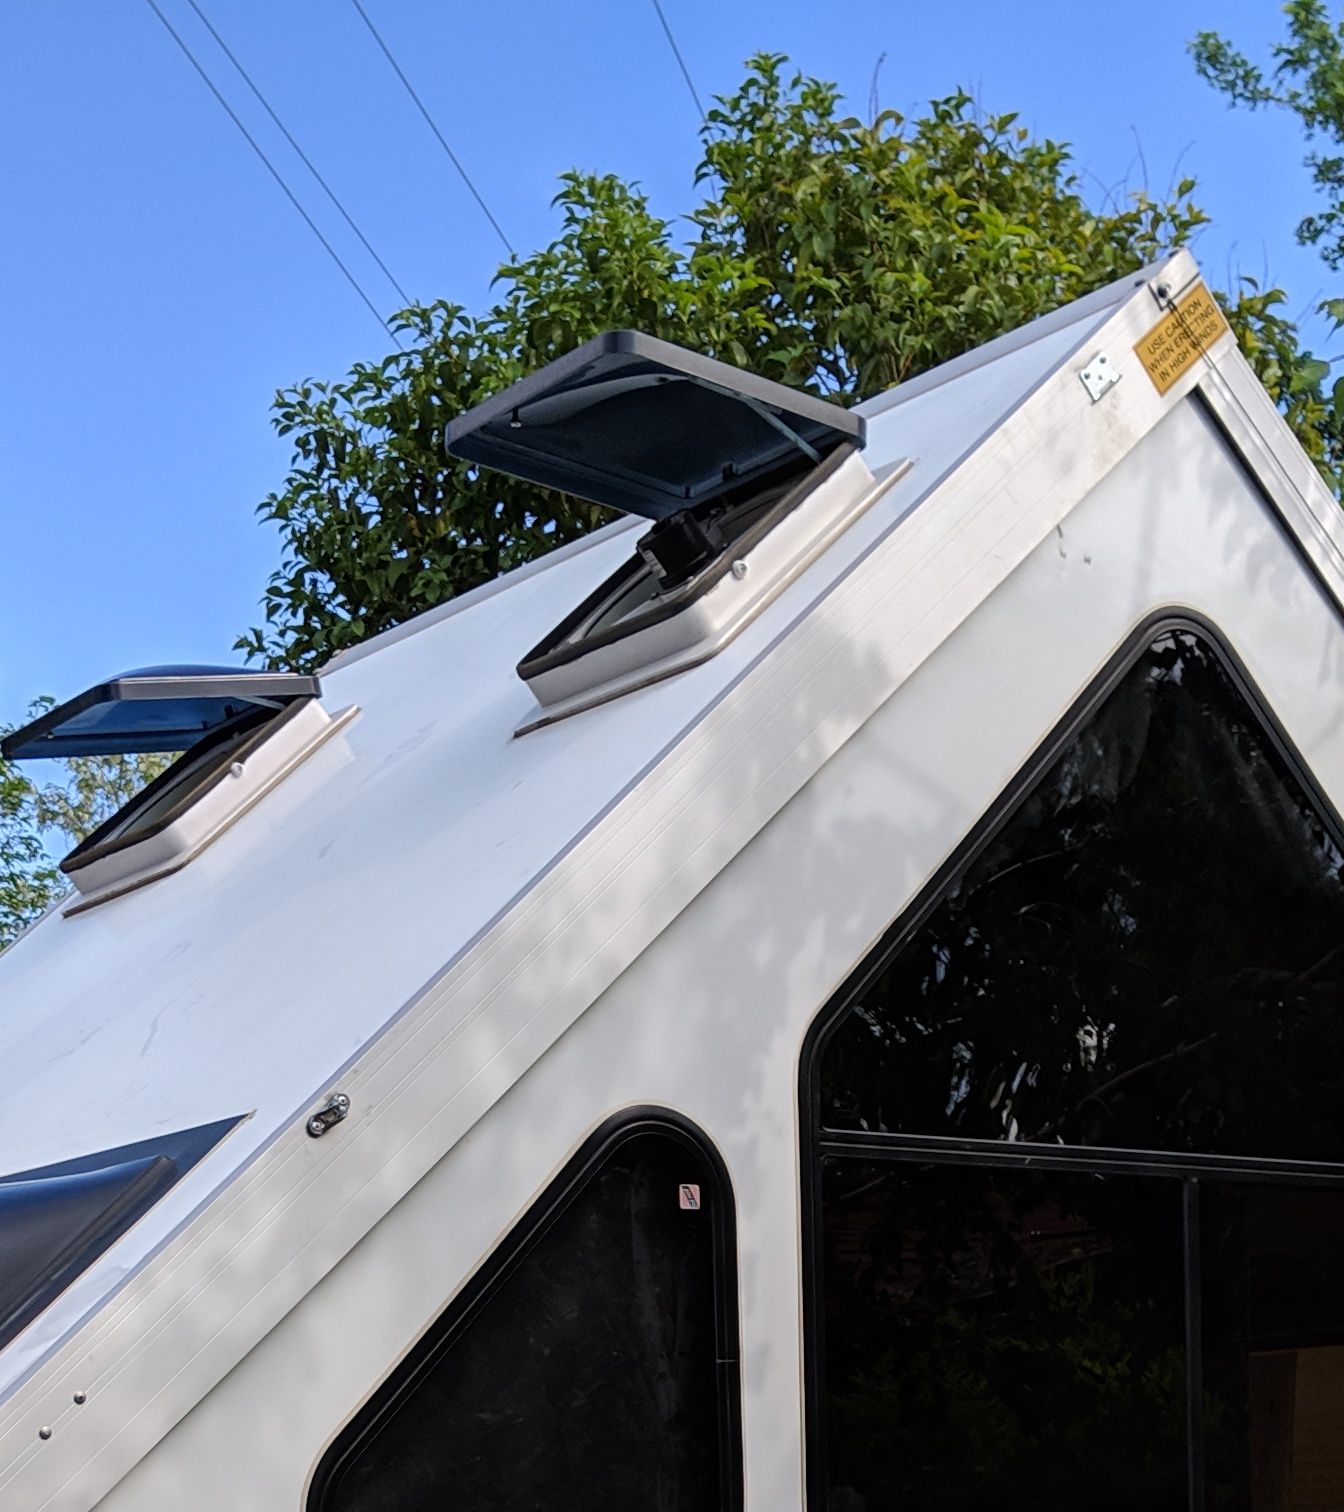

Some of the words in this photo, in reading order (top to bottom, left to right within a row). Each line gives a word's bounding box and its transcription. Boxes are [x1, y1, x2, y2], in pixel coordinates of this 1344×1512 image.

[1147, 334, 1167, 355] USE
[1165, 299, 1202, 337] CAUTION
[1148, 346, 1174, 373] WHEN
[1159, 369, 1171, 382] IN
[1169, 347, 1191, 371] HIGH
